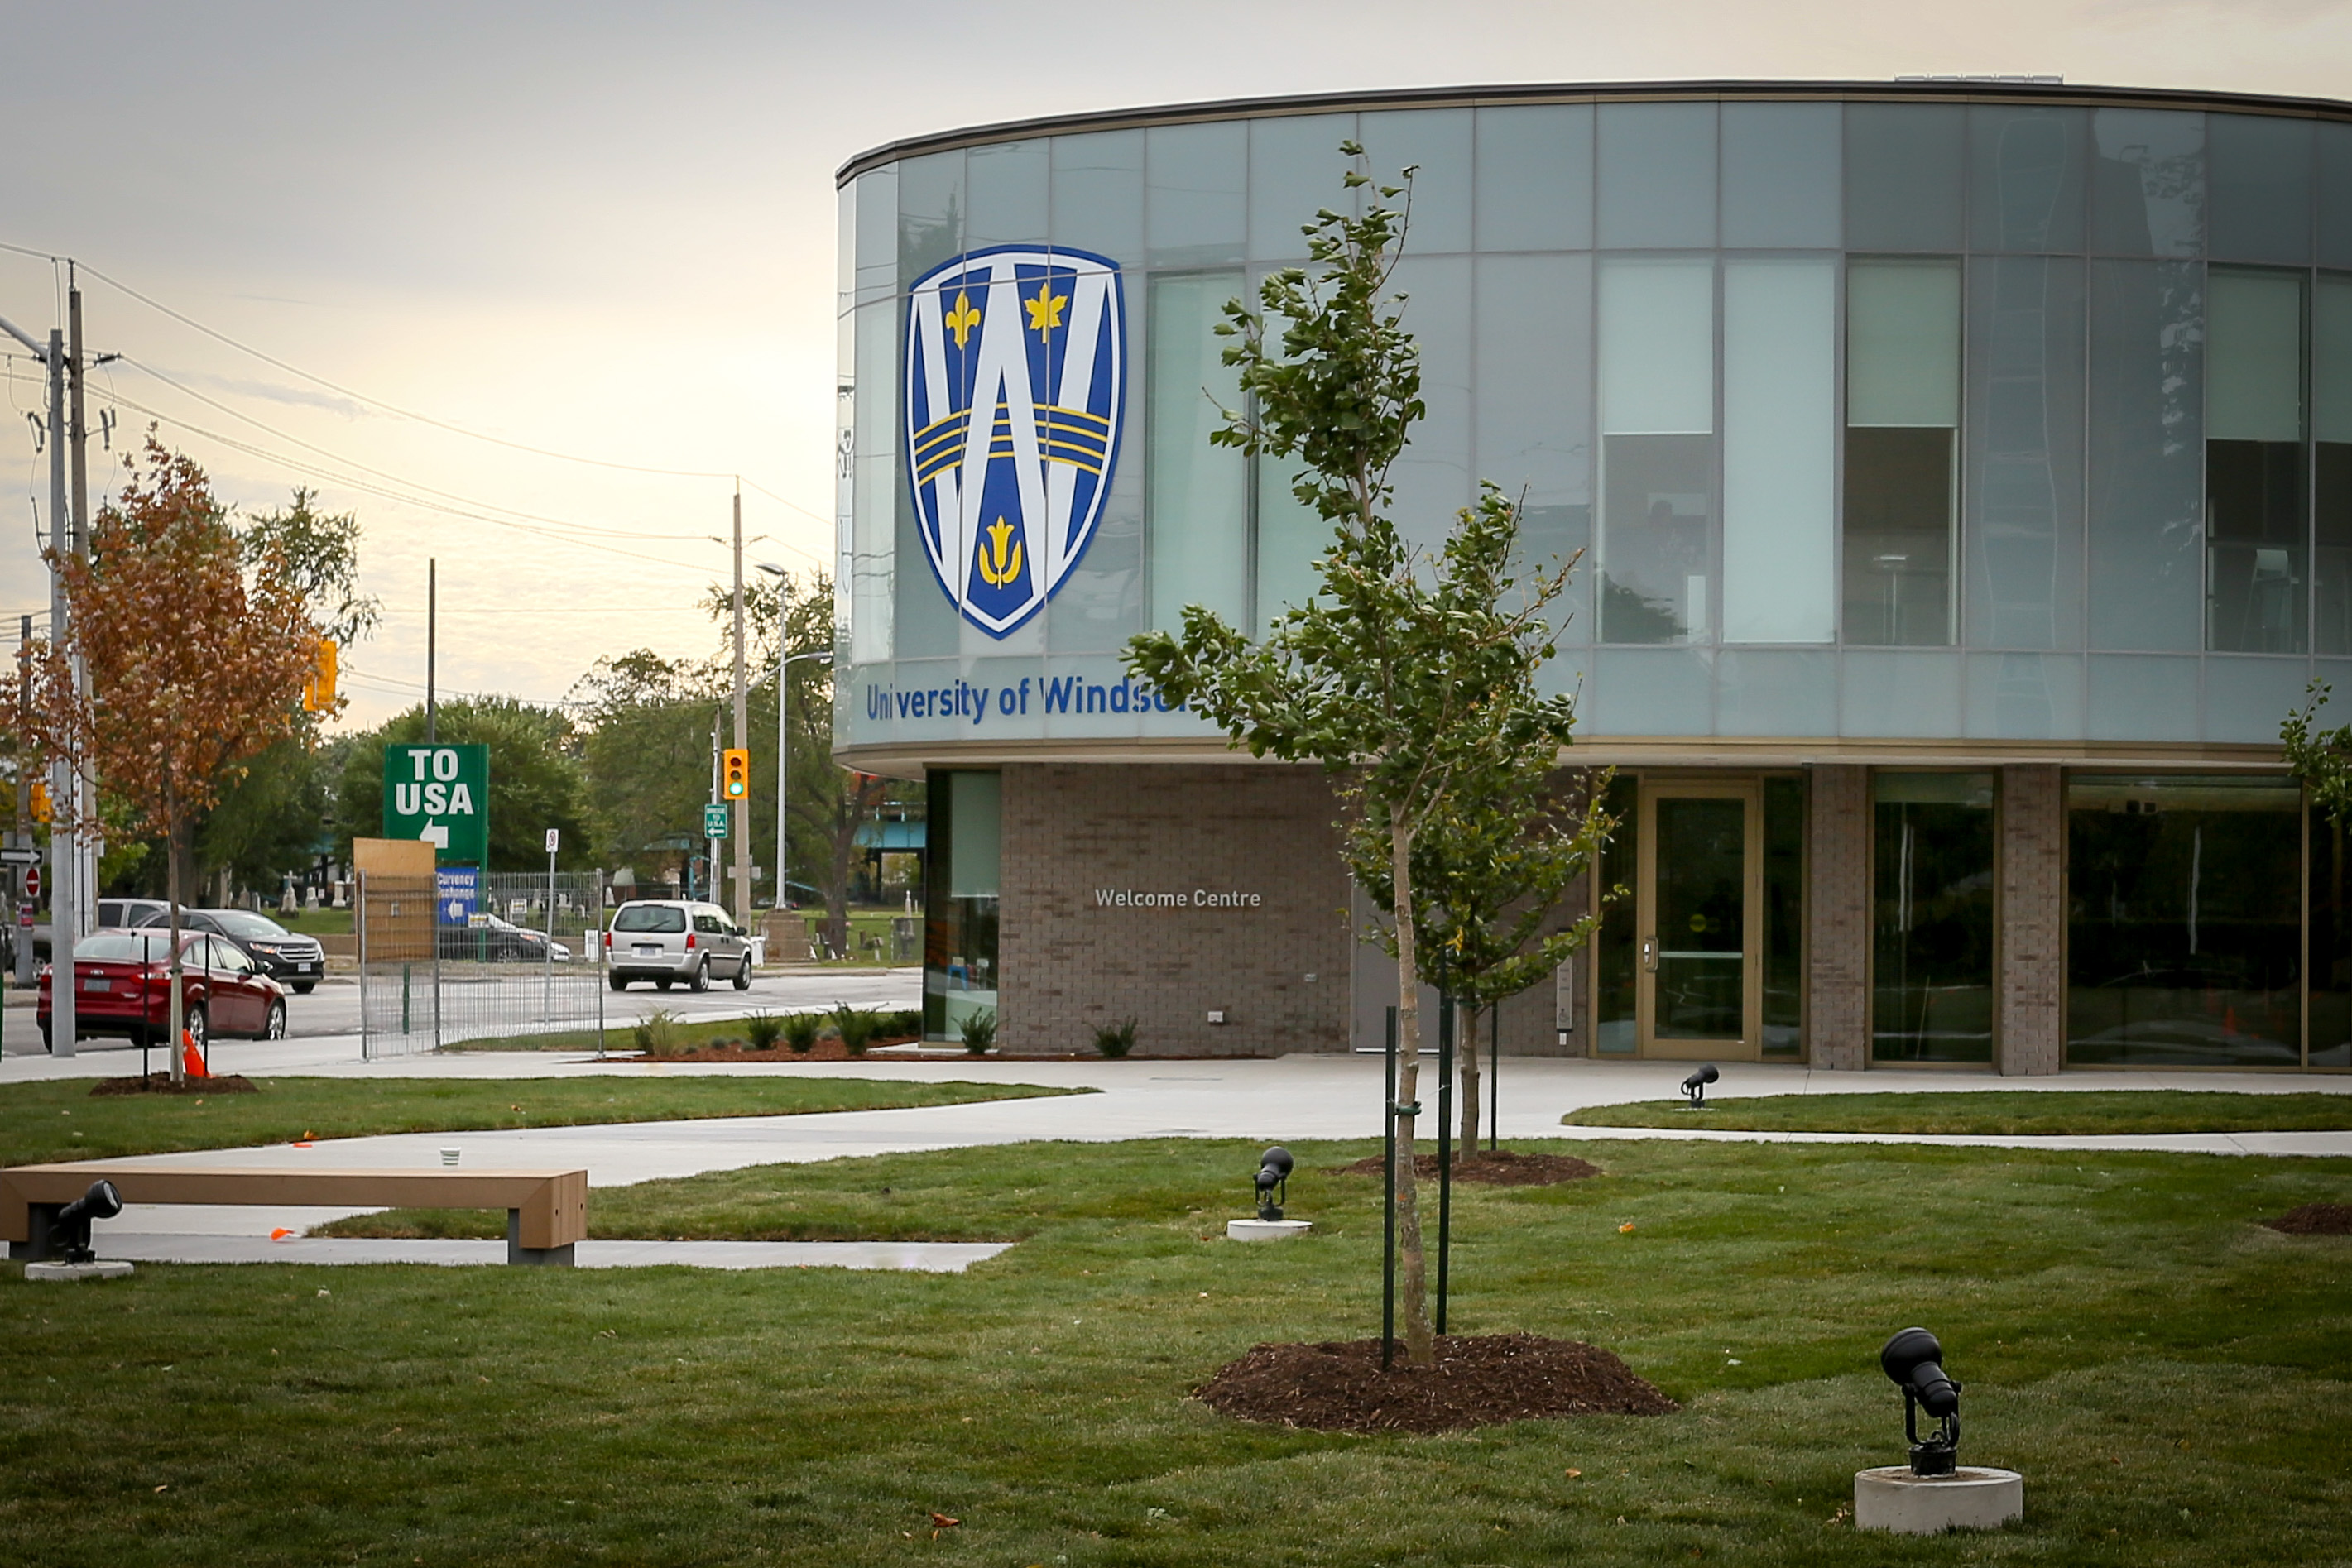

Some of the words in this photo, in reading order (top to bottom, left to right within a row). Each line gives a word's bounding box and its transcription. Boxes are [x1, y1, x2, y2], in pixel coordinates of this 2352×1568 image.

[867, 679, 989, 725] University
[999, 677, 1030, 715] of
[1038, 675, 1186, 713] Winds
[408, 749, 458, 781] TO
[396, 783, 474, 815] USA
[437, 873, 474, 886] Currency
[1095, 889, 1188, 906] Welcome
[1193, 889, 1261, 906] Centre
